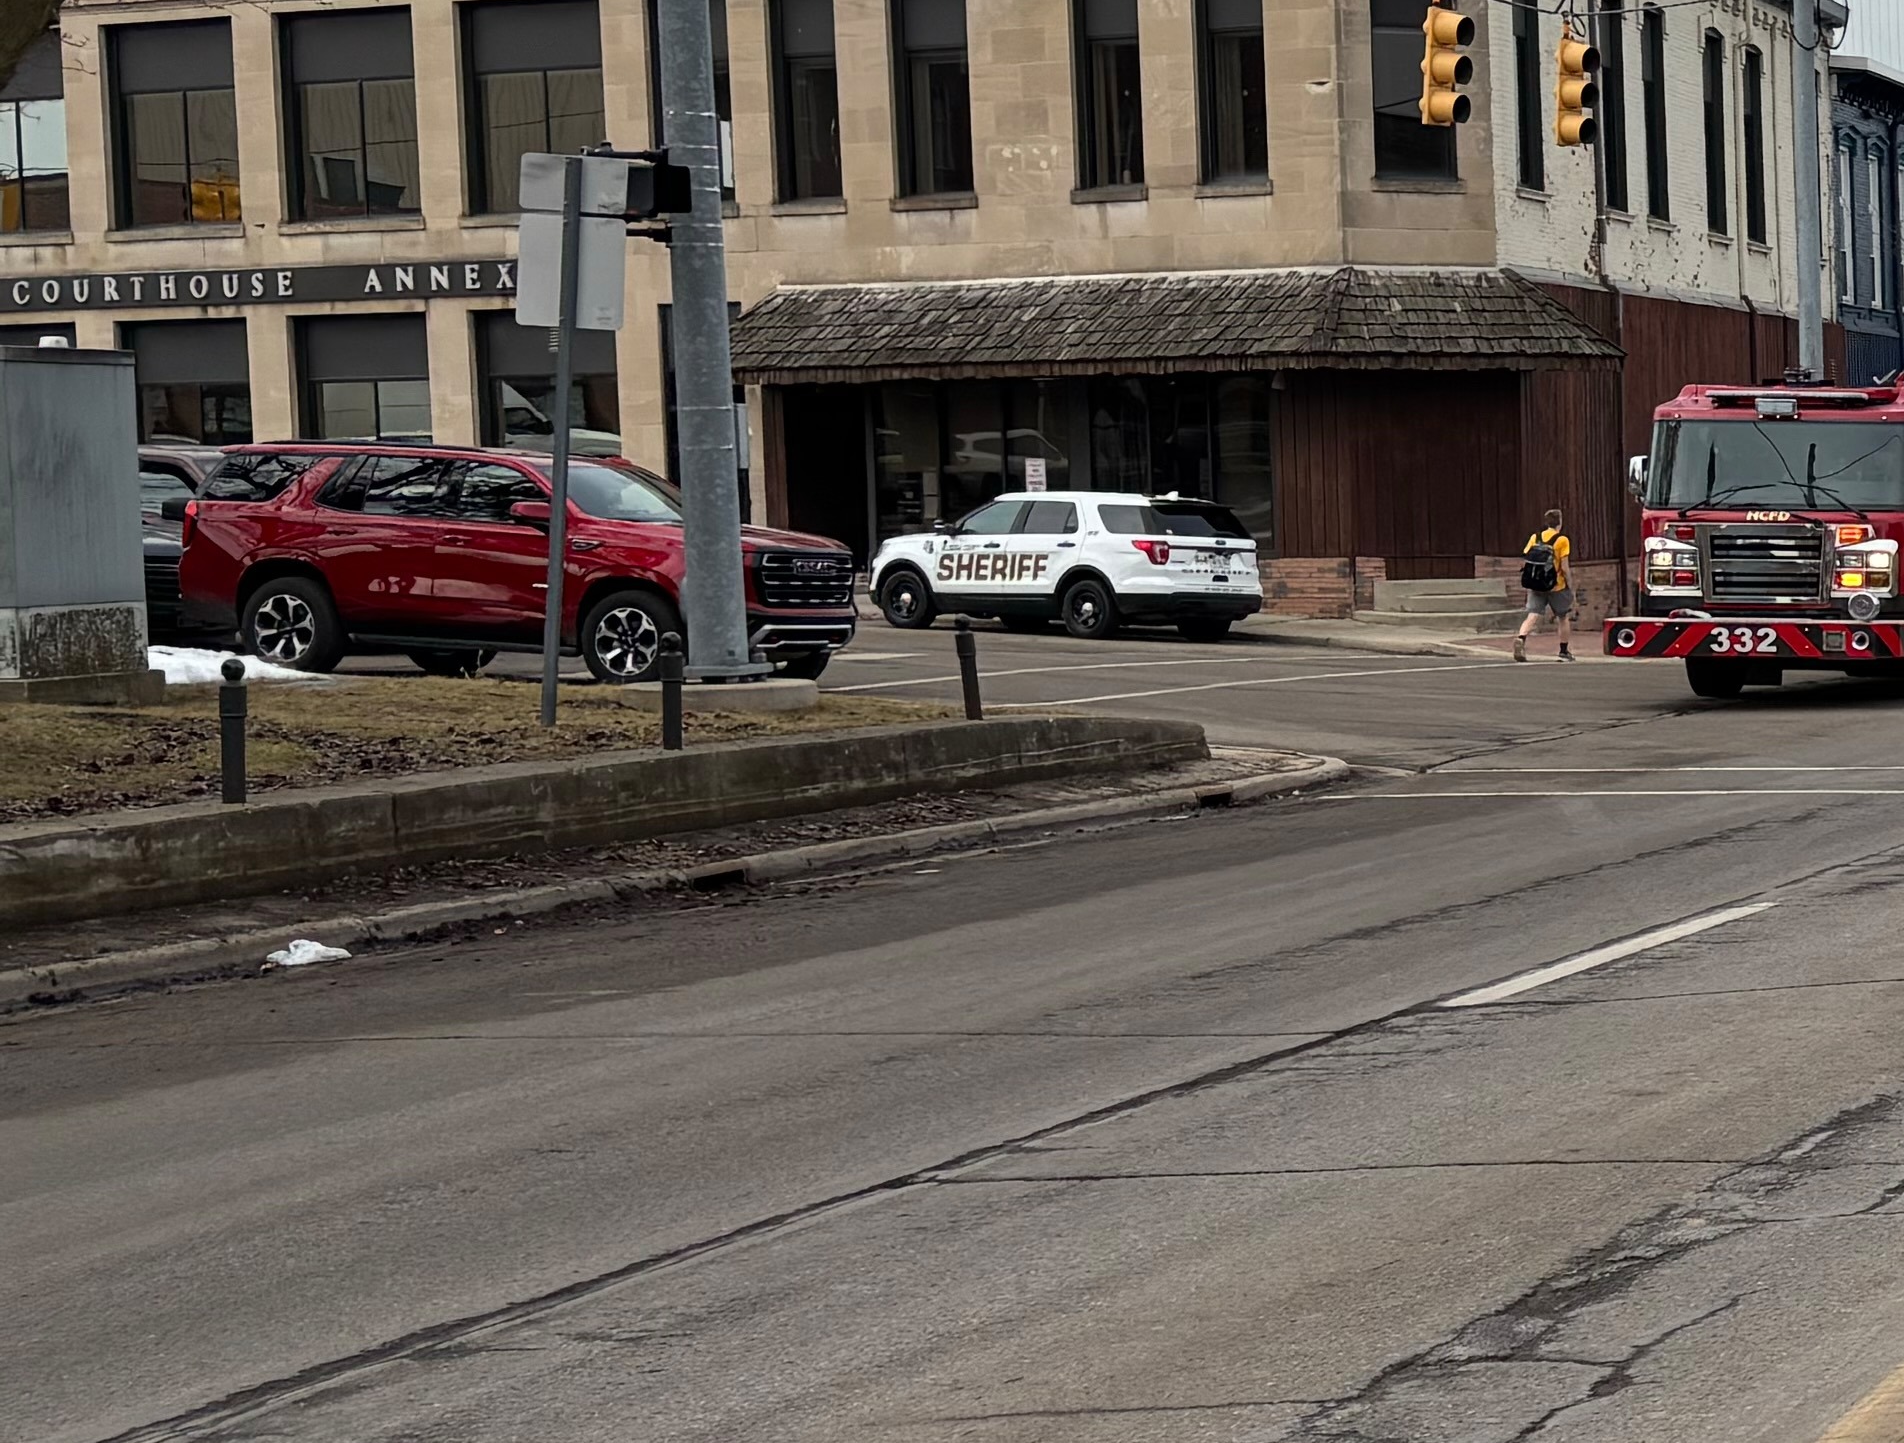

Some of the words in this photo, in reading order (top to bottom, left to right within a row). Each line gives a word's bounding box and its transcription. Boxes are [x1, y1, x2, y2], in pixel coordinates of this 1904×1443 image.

[12, 270, 293, 306] COURTHOUSE
[364, 263, 515, 294] ANNEX
[936, 553, 1049, 581] SHERIFF
[1710, 627, 1778, 653] 332
